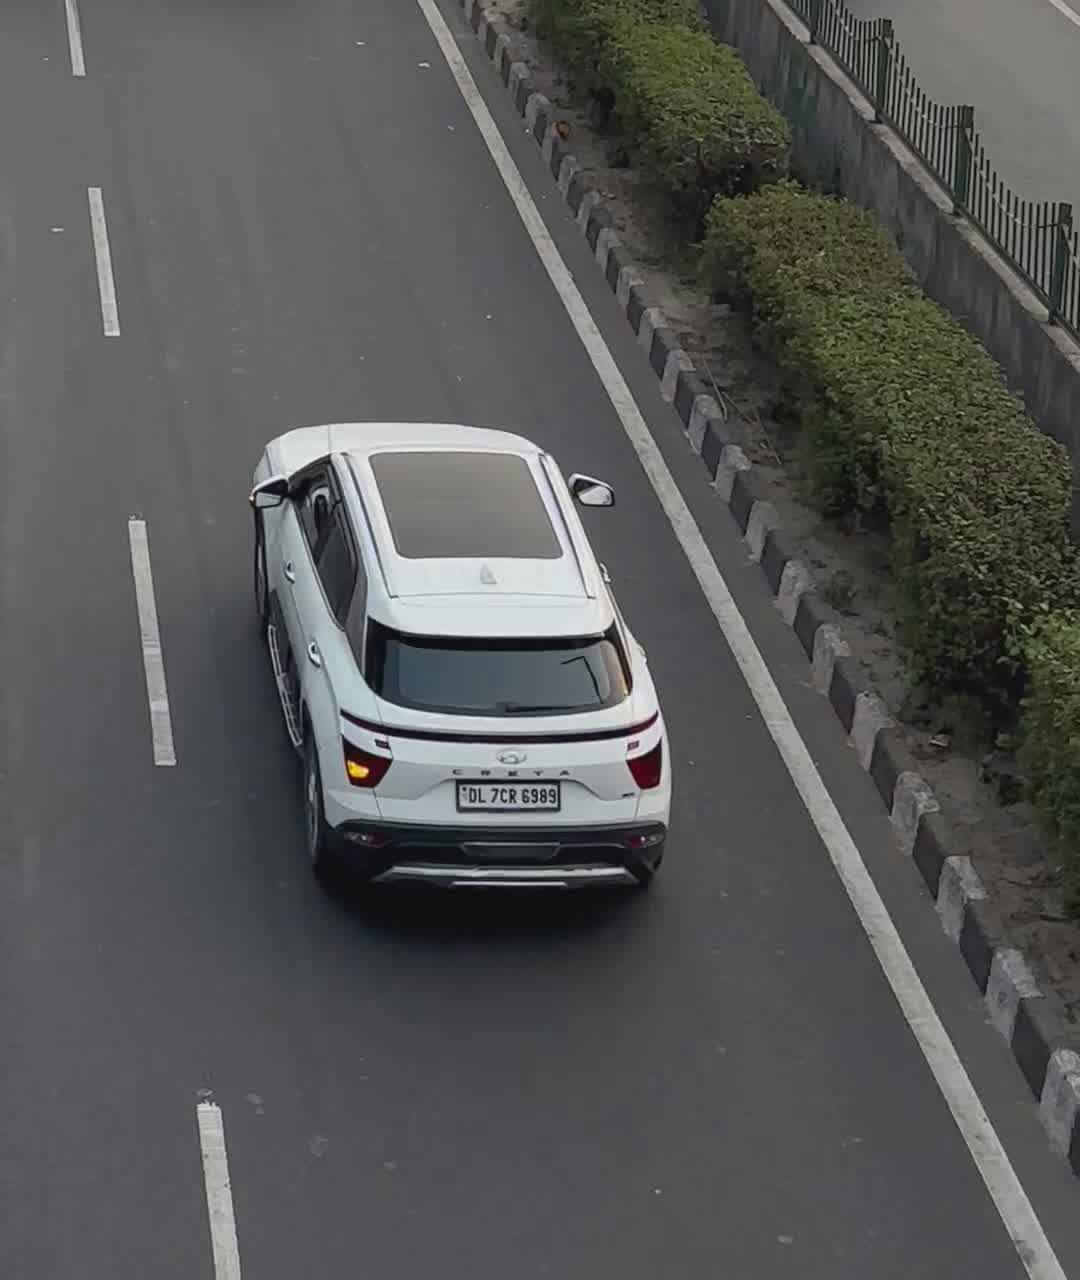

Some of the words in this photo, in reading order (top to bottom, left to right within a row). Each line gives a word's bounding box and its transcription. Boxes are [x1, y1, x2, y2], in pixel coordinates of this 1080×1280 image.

[469, 787, 487, 803] DL
[491, 787, 517, 803] 7CR
[521, 787, 557, 804] 6989
